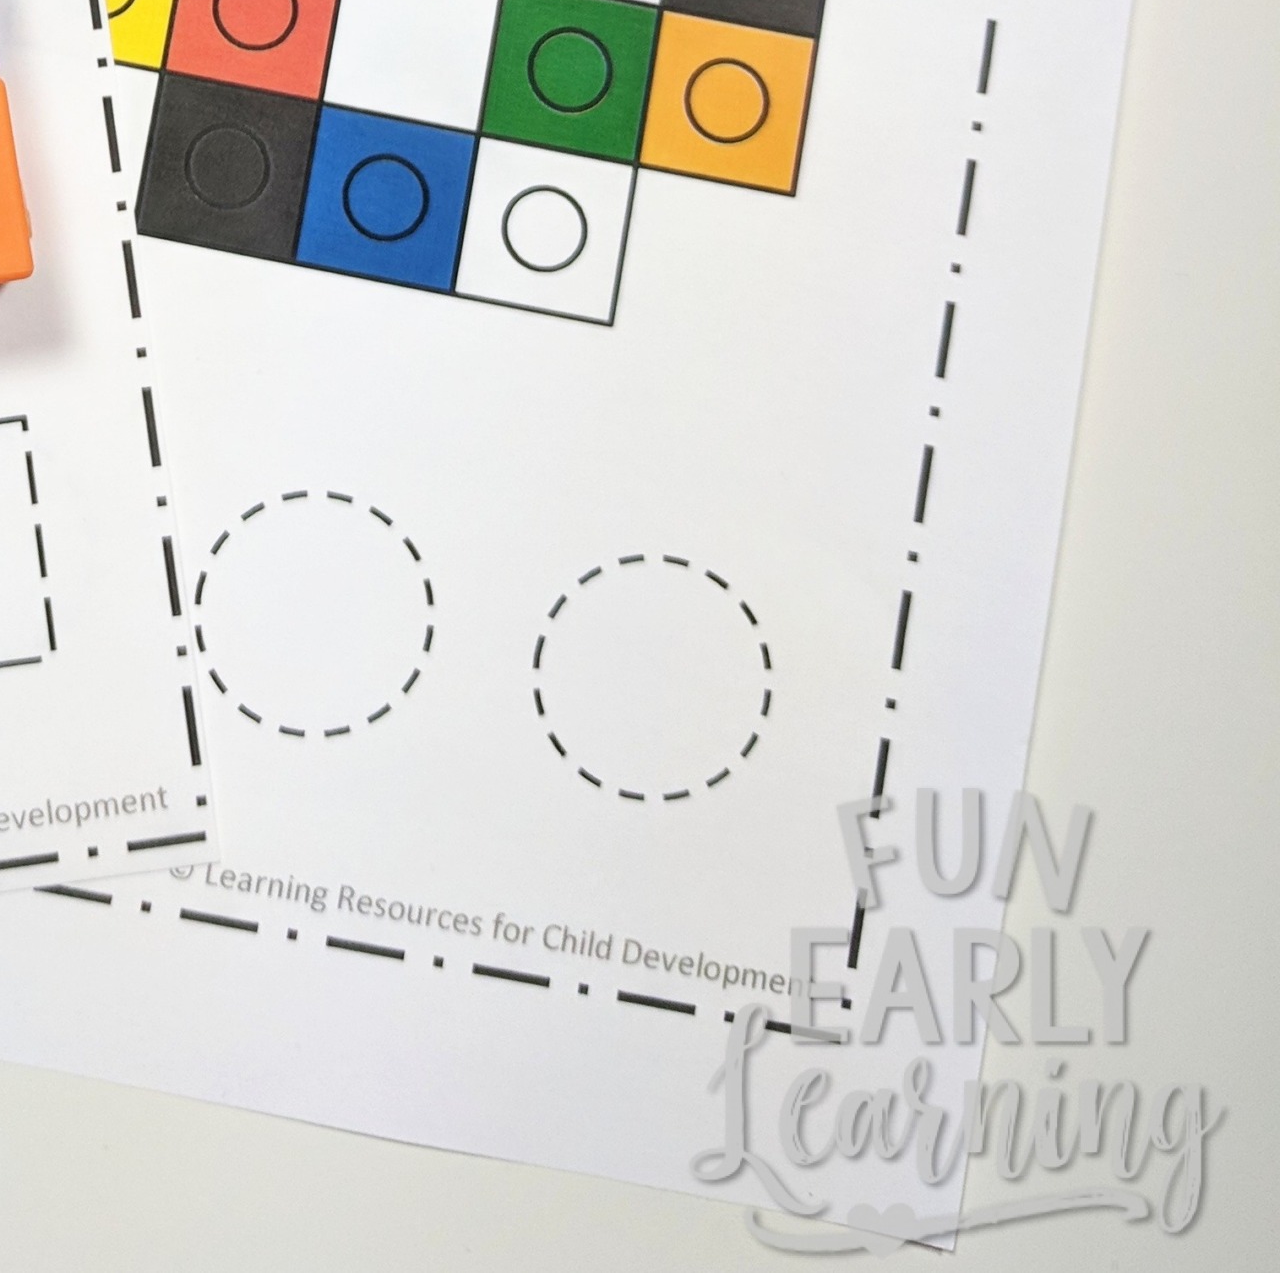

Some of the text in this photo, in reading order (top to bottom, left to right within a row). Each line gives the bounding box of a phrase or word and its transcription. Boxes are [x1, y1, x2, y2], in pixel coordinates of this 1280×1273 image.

[204, 861, 328, 911] Learning
[337, 884, 483, 938] Resources
[491, 915, 535, 946] for
[542, 924, 614, 962] Child
